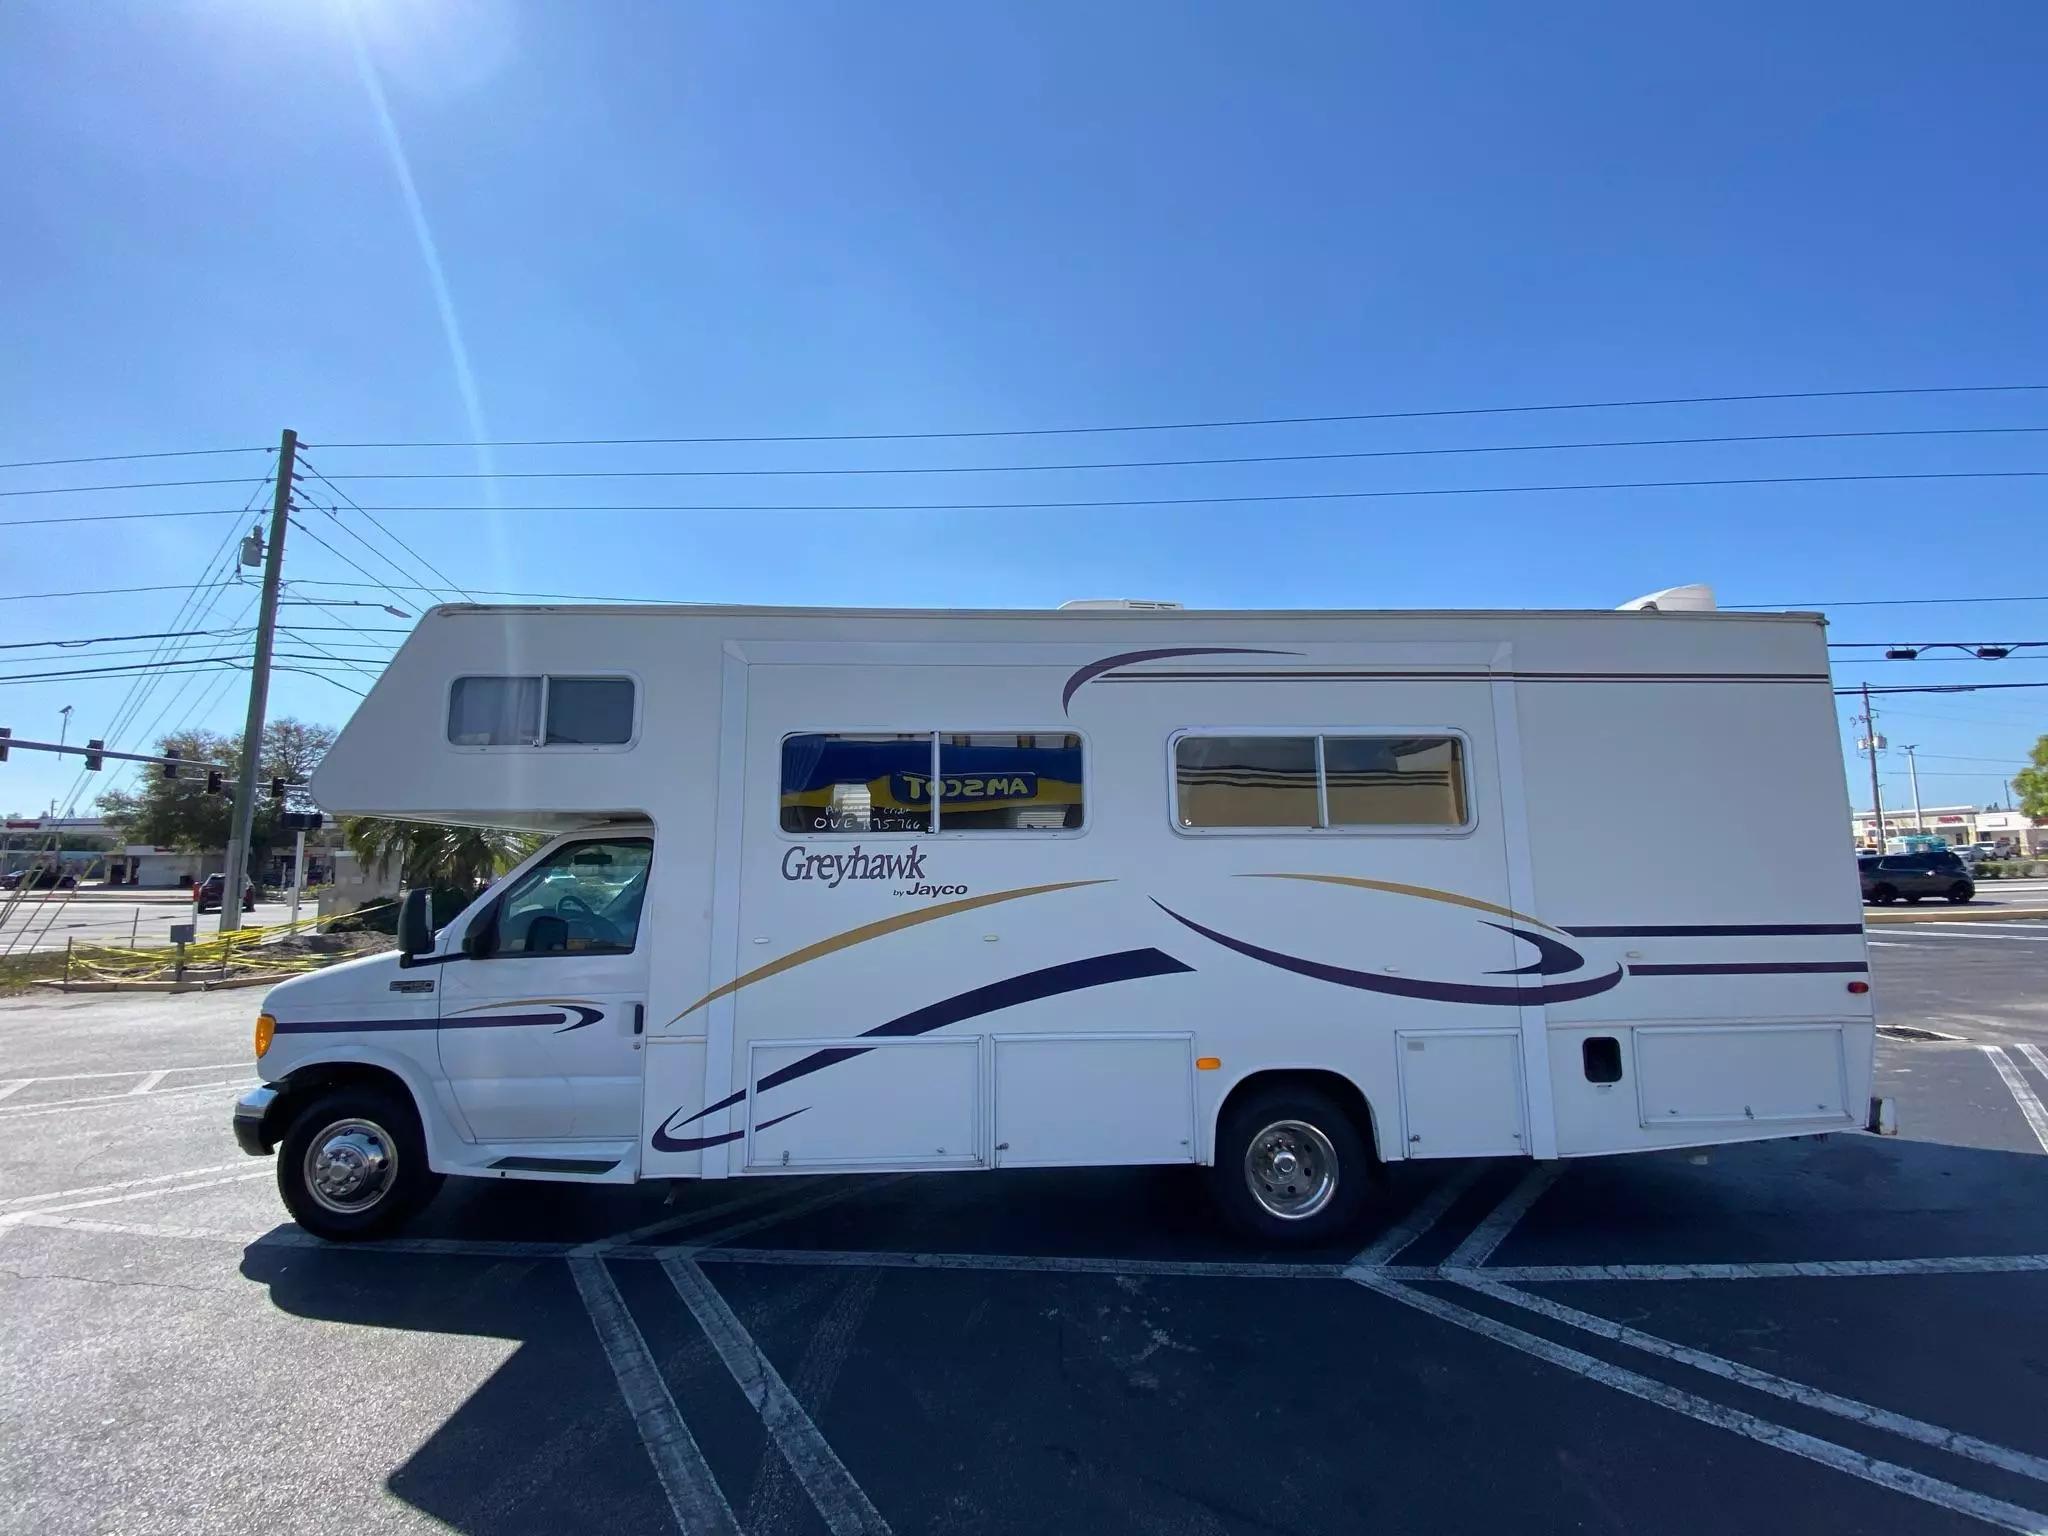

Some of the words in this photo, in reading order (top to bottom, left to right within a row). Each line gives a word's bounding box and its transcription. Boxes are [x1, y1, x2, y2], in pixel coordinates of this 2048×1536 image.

[781, 844, 928, 889] Greyhawk
[893, 889, 905, 897] by
[906, 882, 968, 899] Jayco
